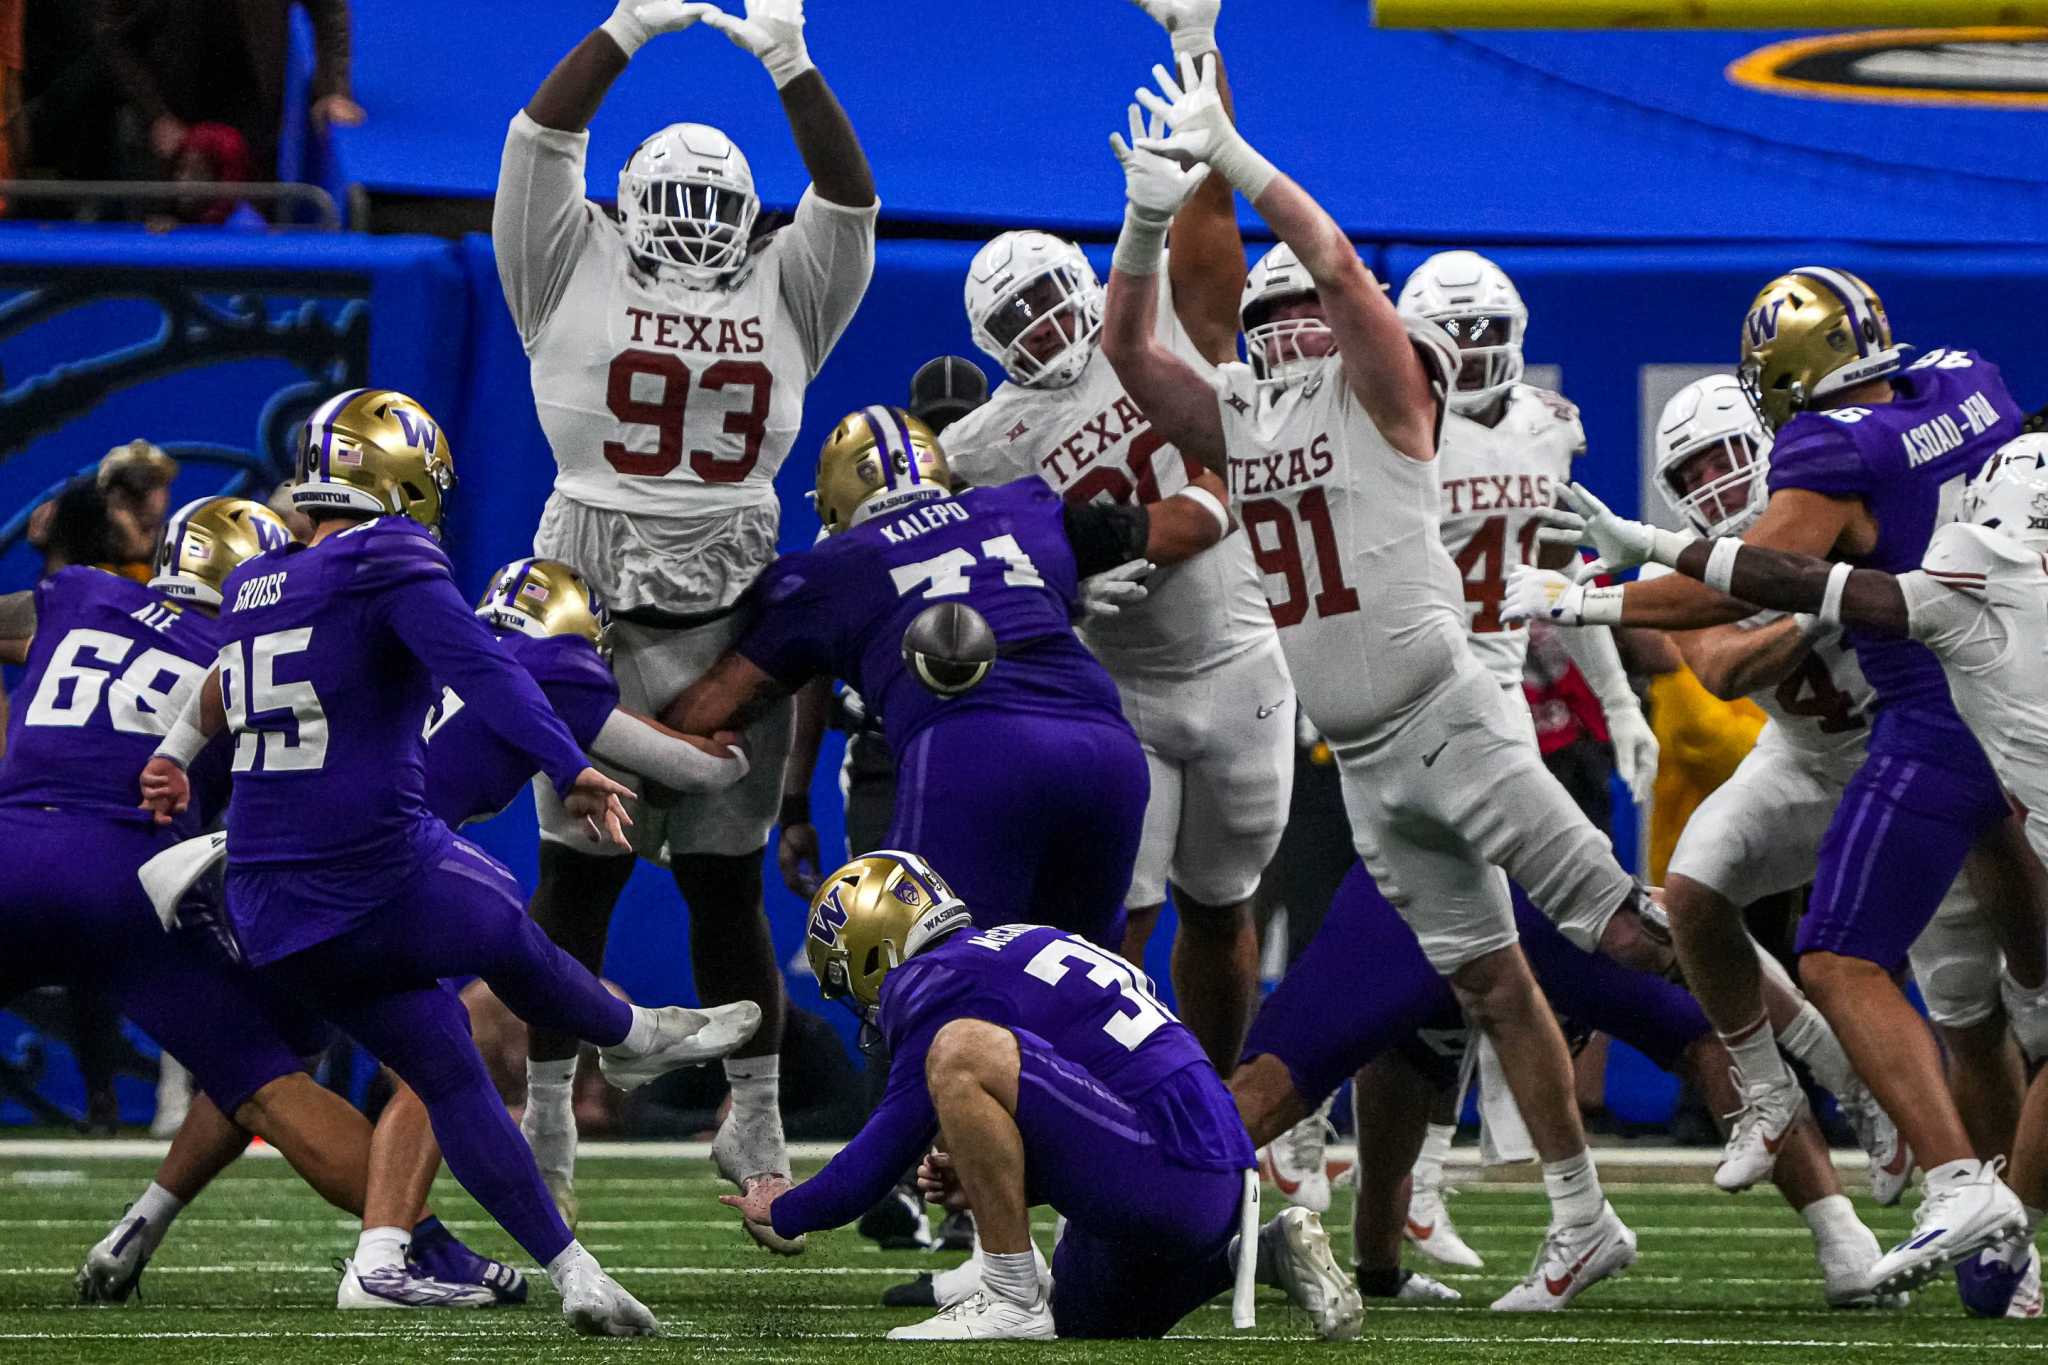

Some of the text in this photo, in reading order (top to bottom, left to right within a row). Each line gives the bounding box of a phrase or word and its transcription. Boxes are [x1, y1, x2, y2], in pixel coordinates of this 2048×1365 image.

[626, 306, 764, 353] TEXAS
[1748, 298, 1786, 347] W
[388, 406, 438, 457] W
[603, 348, 774, 483] 93
[1041, 395, 1151, 484] TEXA
[1229, 432, 1334, 495] TEXAS
[1443, 474, 1550, 514] TEXAS
[880, 502, 970, 544] KALEPO
[889, 533, 1045, 599] 71
[1241, 485, 1361, 630] 91
[131, 602, 180, 633] ALE
[232, 571, 288, 613] GROSS
[25, 628, 209, 736] 68
[808, 883, 849, 946] W
